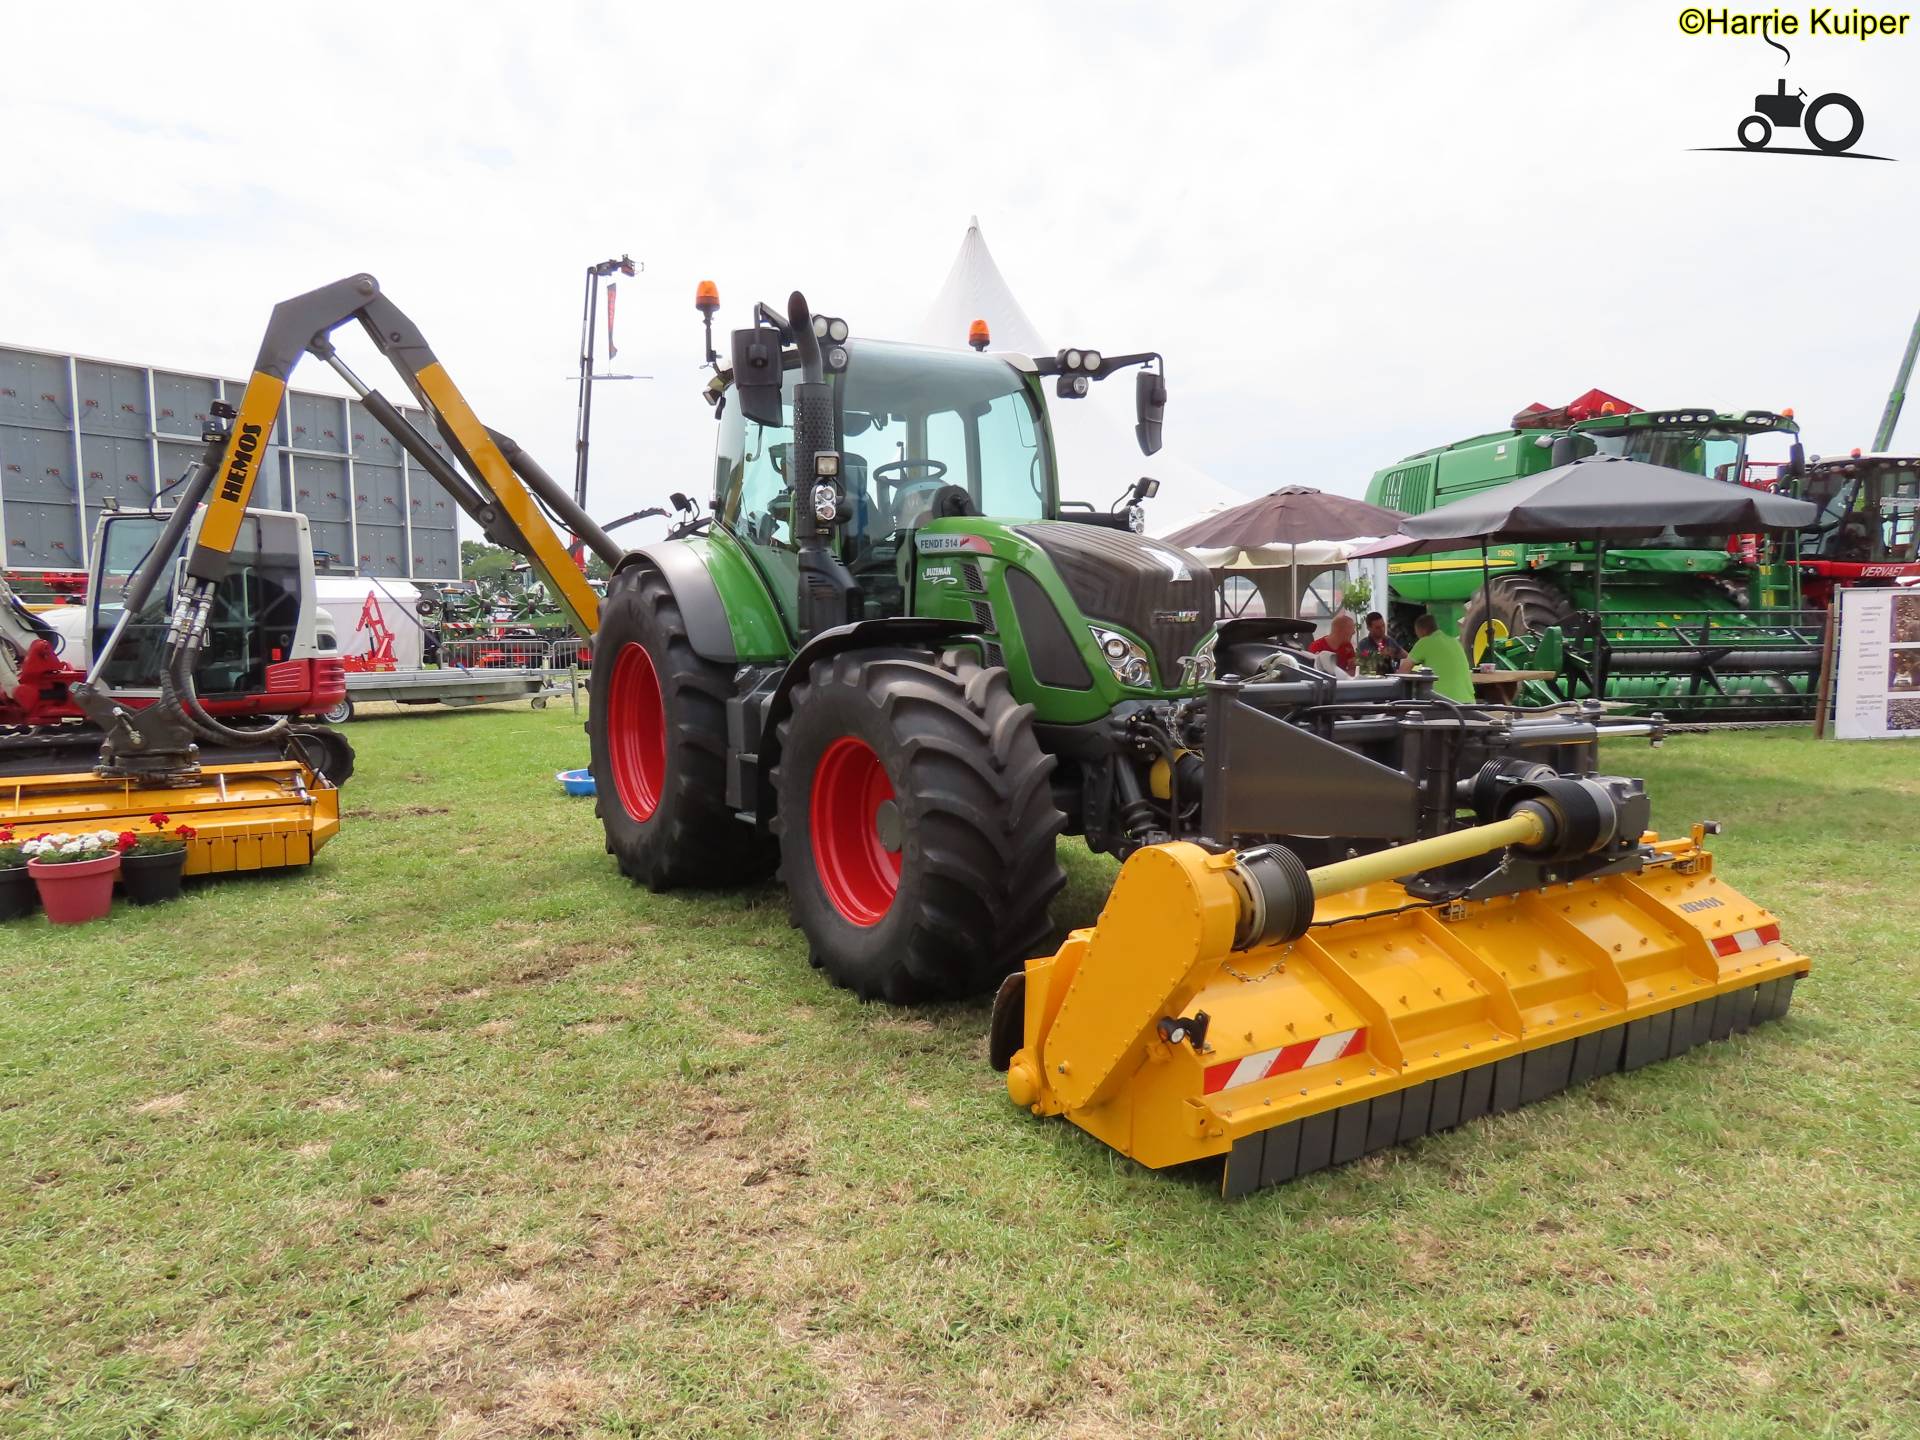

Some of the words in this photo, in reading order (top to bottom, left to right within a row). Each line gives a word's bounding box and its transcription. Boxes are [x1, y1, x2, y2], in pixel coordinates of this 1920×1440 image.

[220, 422, 262, 503] HEMOS
[920, 539, 944, 549] FENDT
[945, 538, 958, 549] 514
[1860, 566, 1905, 577] VERVAET
